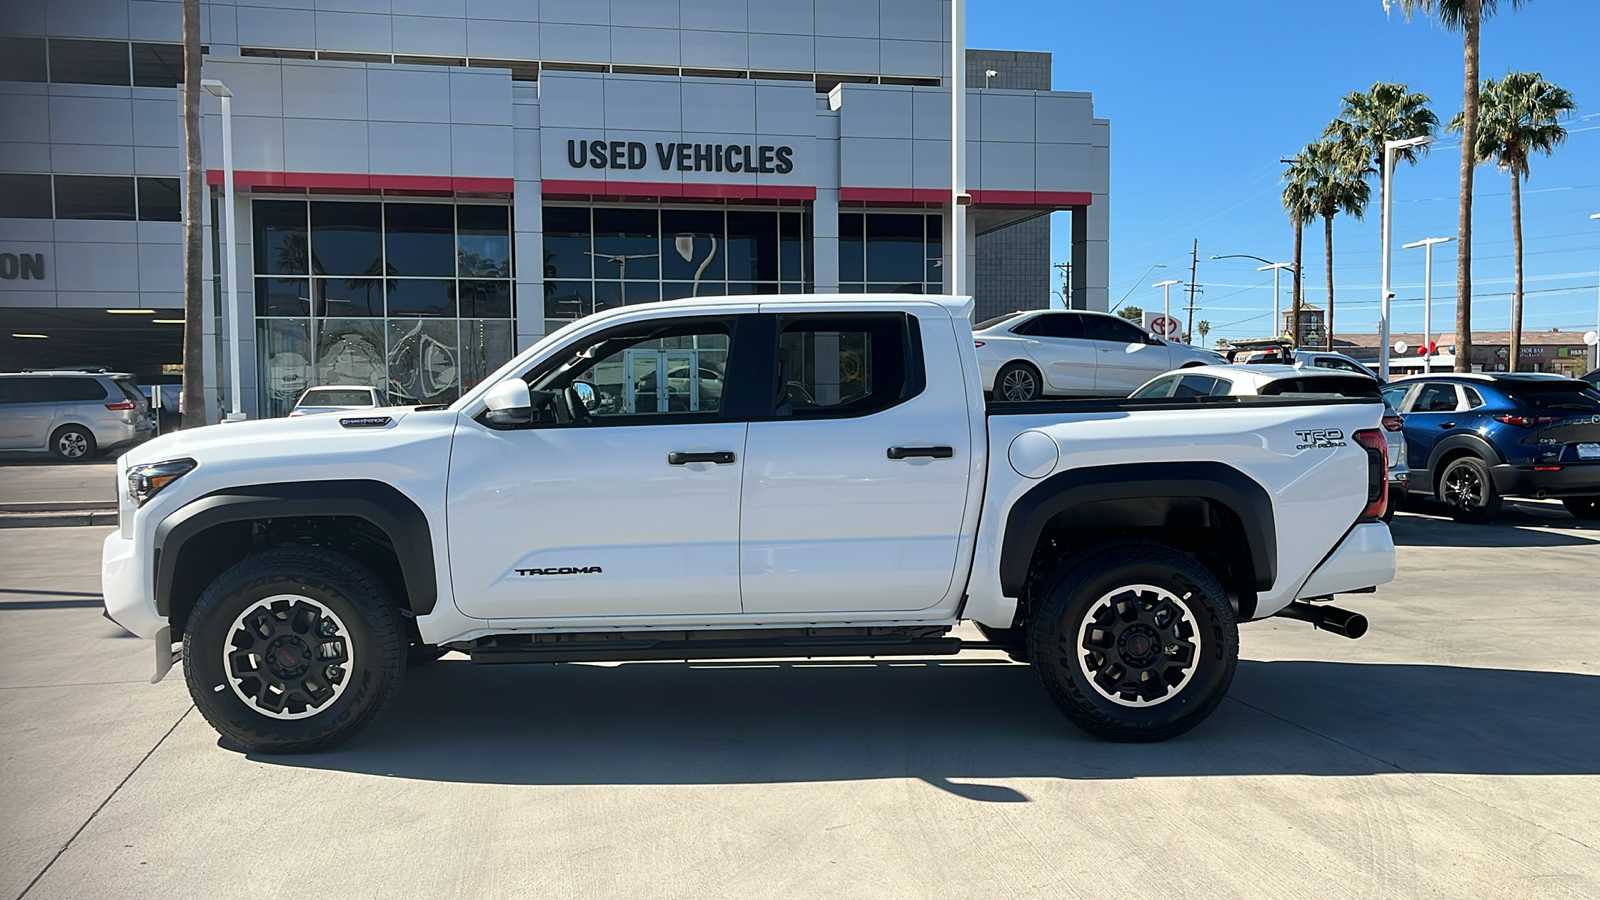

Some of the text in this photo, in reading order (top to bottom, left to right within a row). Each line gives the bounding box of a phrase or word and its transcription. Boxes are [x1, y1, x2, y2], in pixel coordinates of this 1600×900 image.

[567, 139, 794, 174] USED VEHICLES
[1295, 428, 1344, 445] TRD
[514, 566, 602, 576] TACOMA
